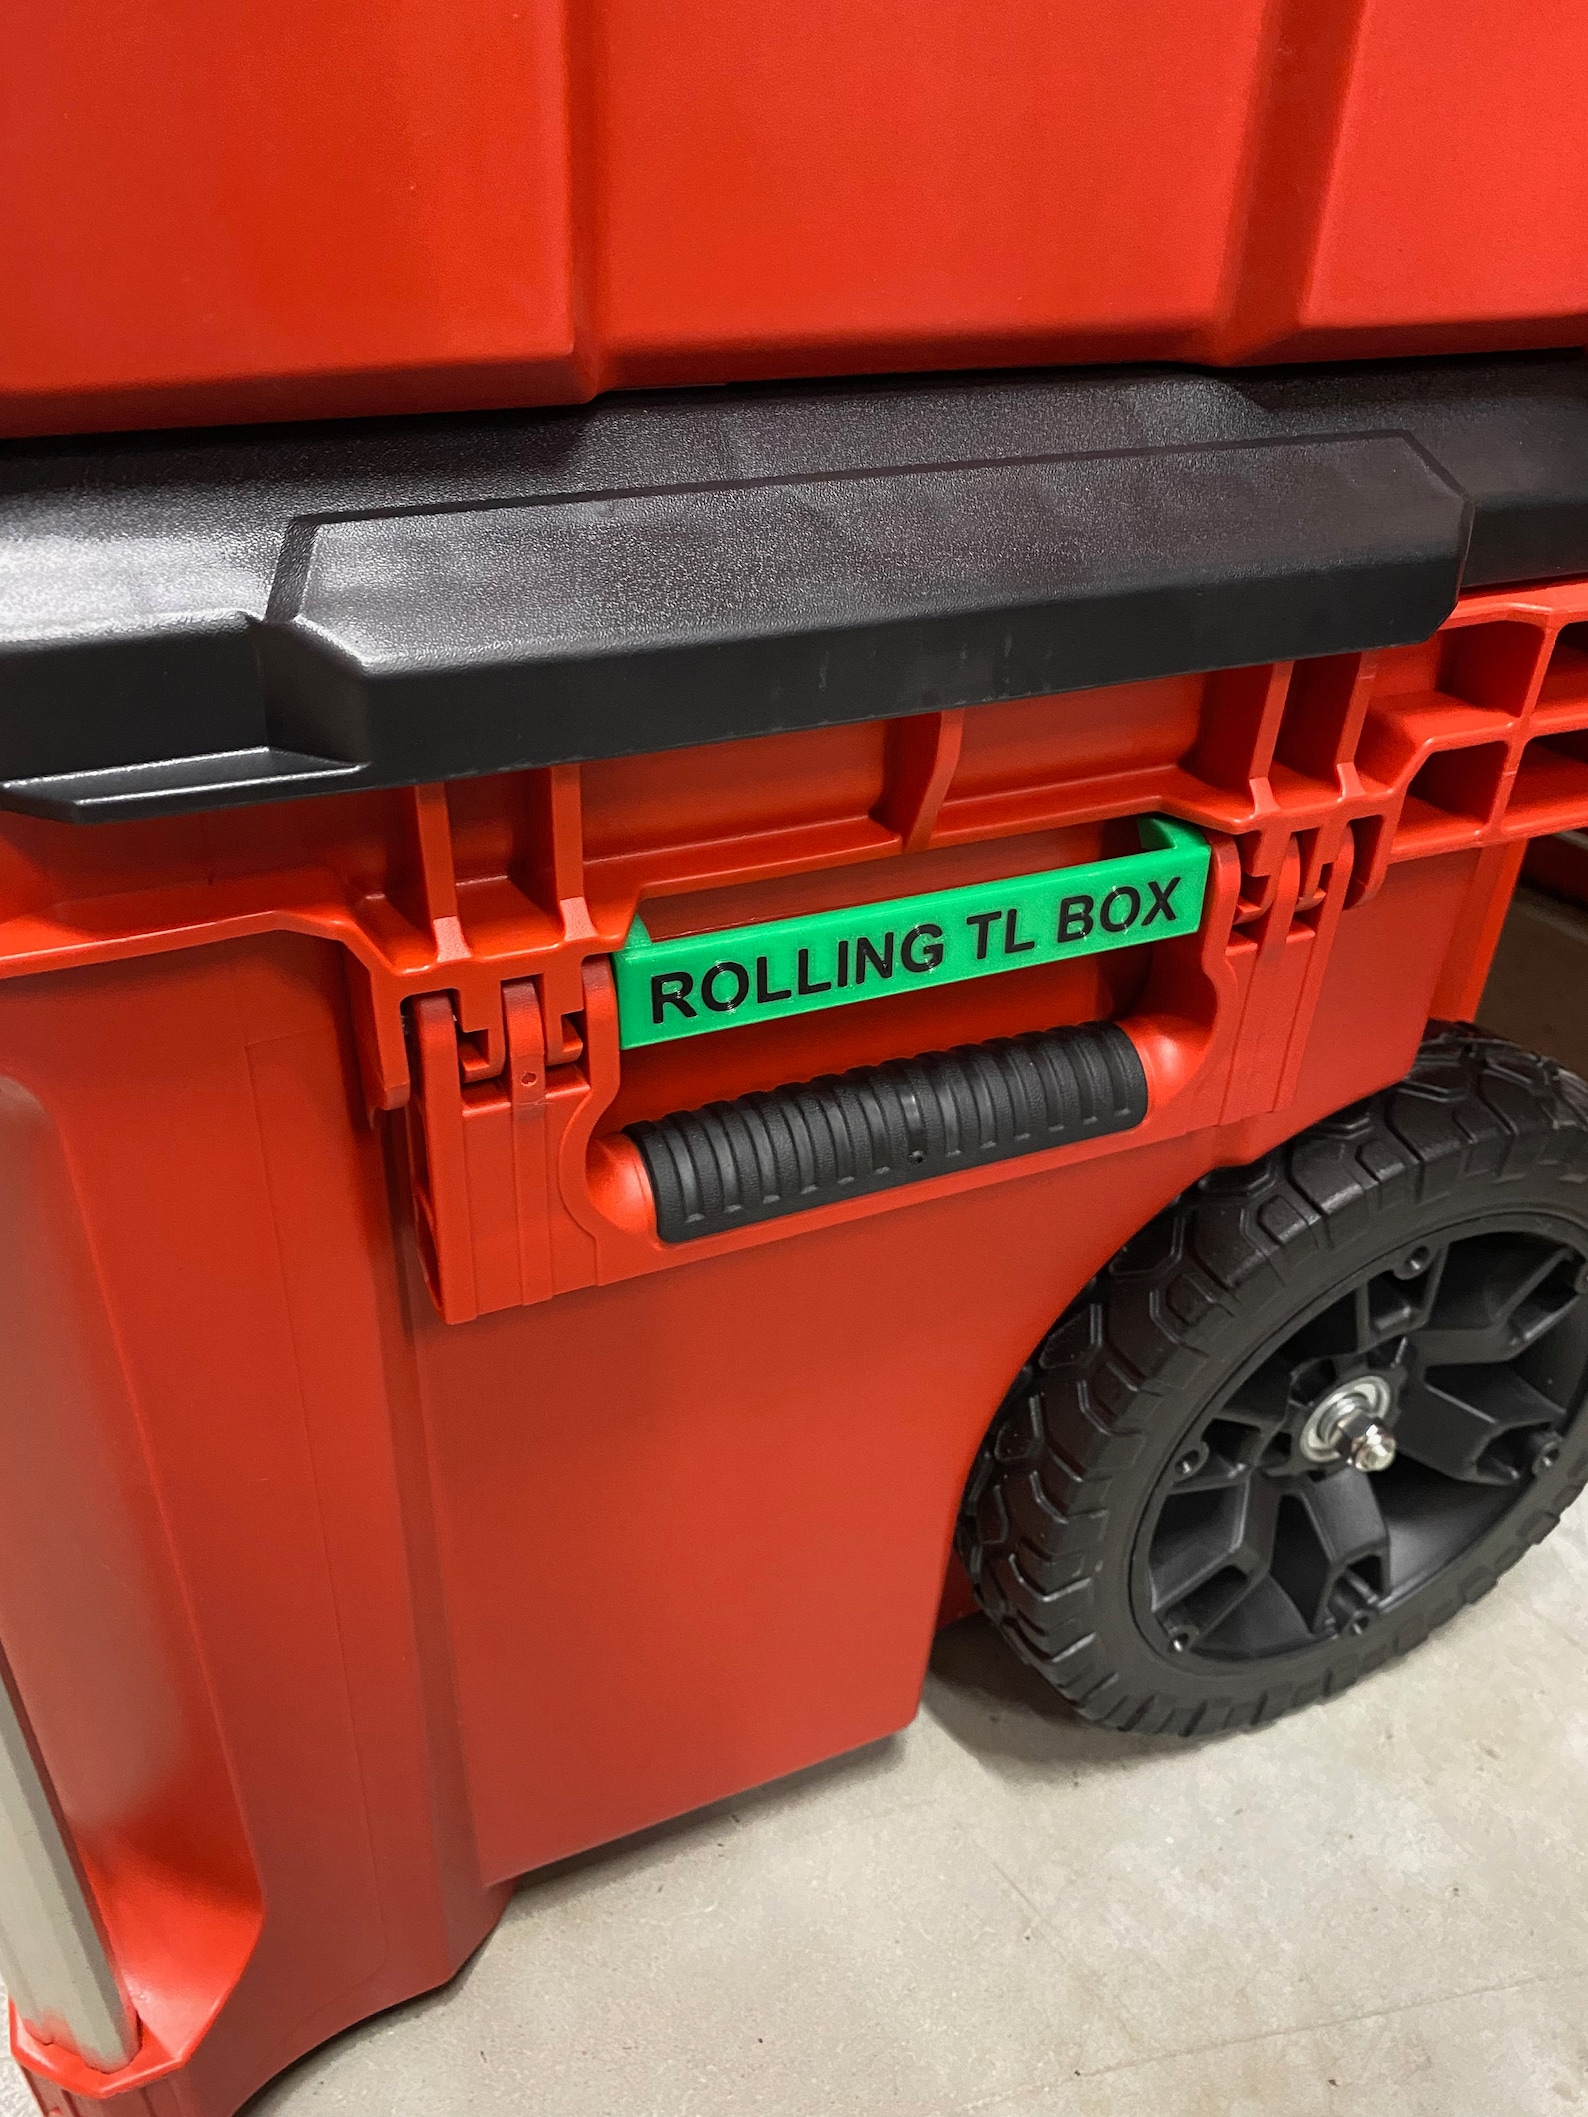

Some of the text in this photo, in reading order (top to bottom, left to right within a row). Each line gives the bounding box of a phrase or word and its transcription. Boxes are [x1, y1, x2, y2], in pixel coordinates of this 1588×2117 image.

[650, 876, 1182, 1024] ROLLING TL BOX
